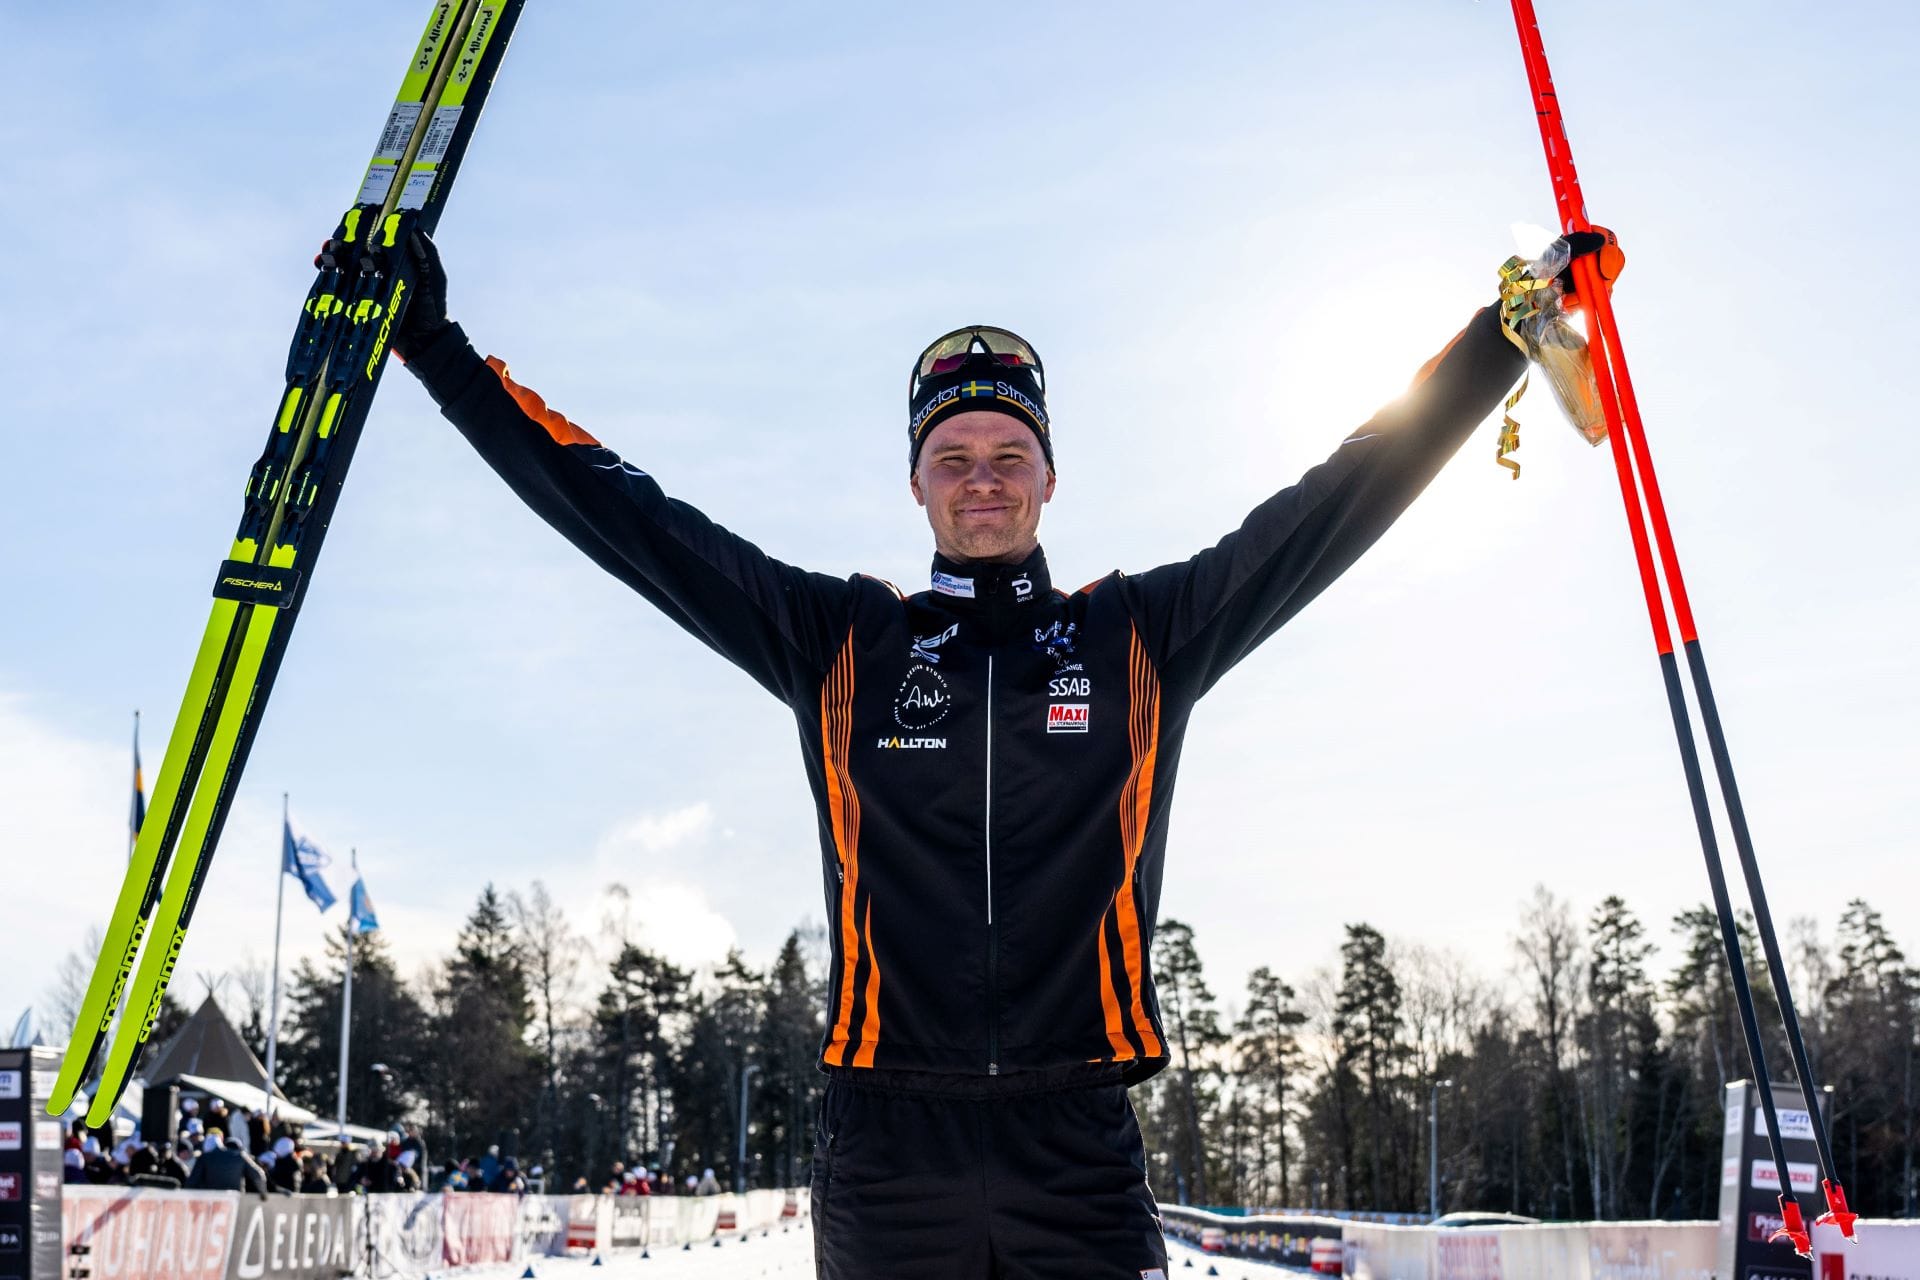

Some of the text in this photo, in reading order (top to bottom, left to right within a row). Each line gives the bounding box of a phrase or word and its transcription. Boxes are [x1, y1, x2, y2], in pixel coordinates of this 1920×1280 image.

[469, 10, 493, 54] Allround
[366, 279, 406, 381] FISCHER
[912, 385, 960, 433] Structor
[996, 381, 1047, 425] Structo
[222, 577, 275, 590] FISCHER
[1048, 678, 1091, 696] SSAB
[877, 736, 947, 749] HALLTON
[100, 914, 149, 1033] speedmax
[138, 923, 188, 1044] speedmax
[62, 1211, 227, 1276] AUHAUS
[271, 1212, 346, 1270] ELEDA
